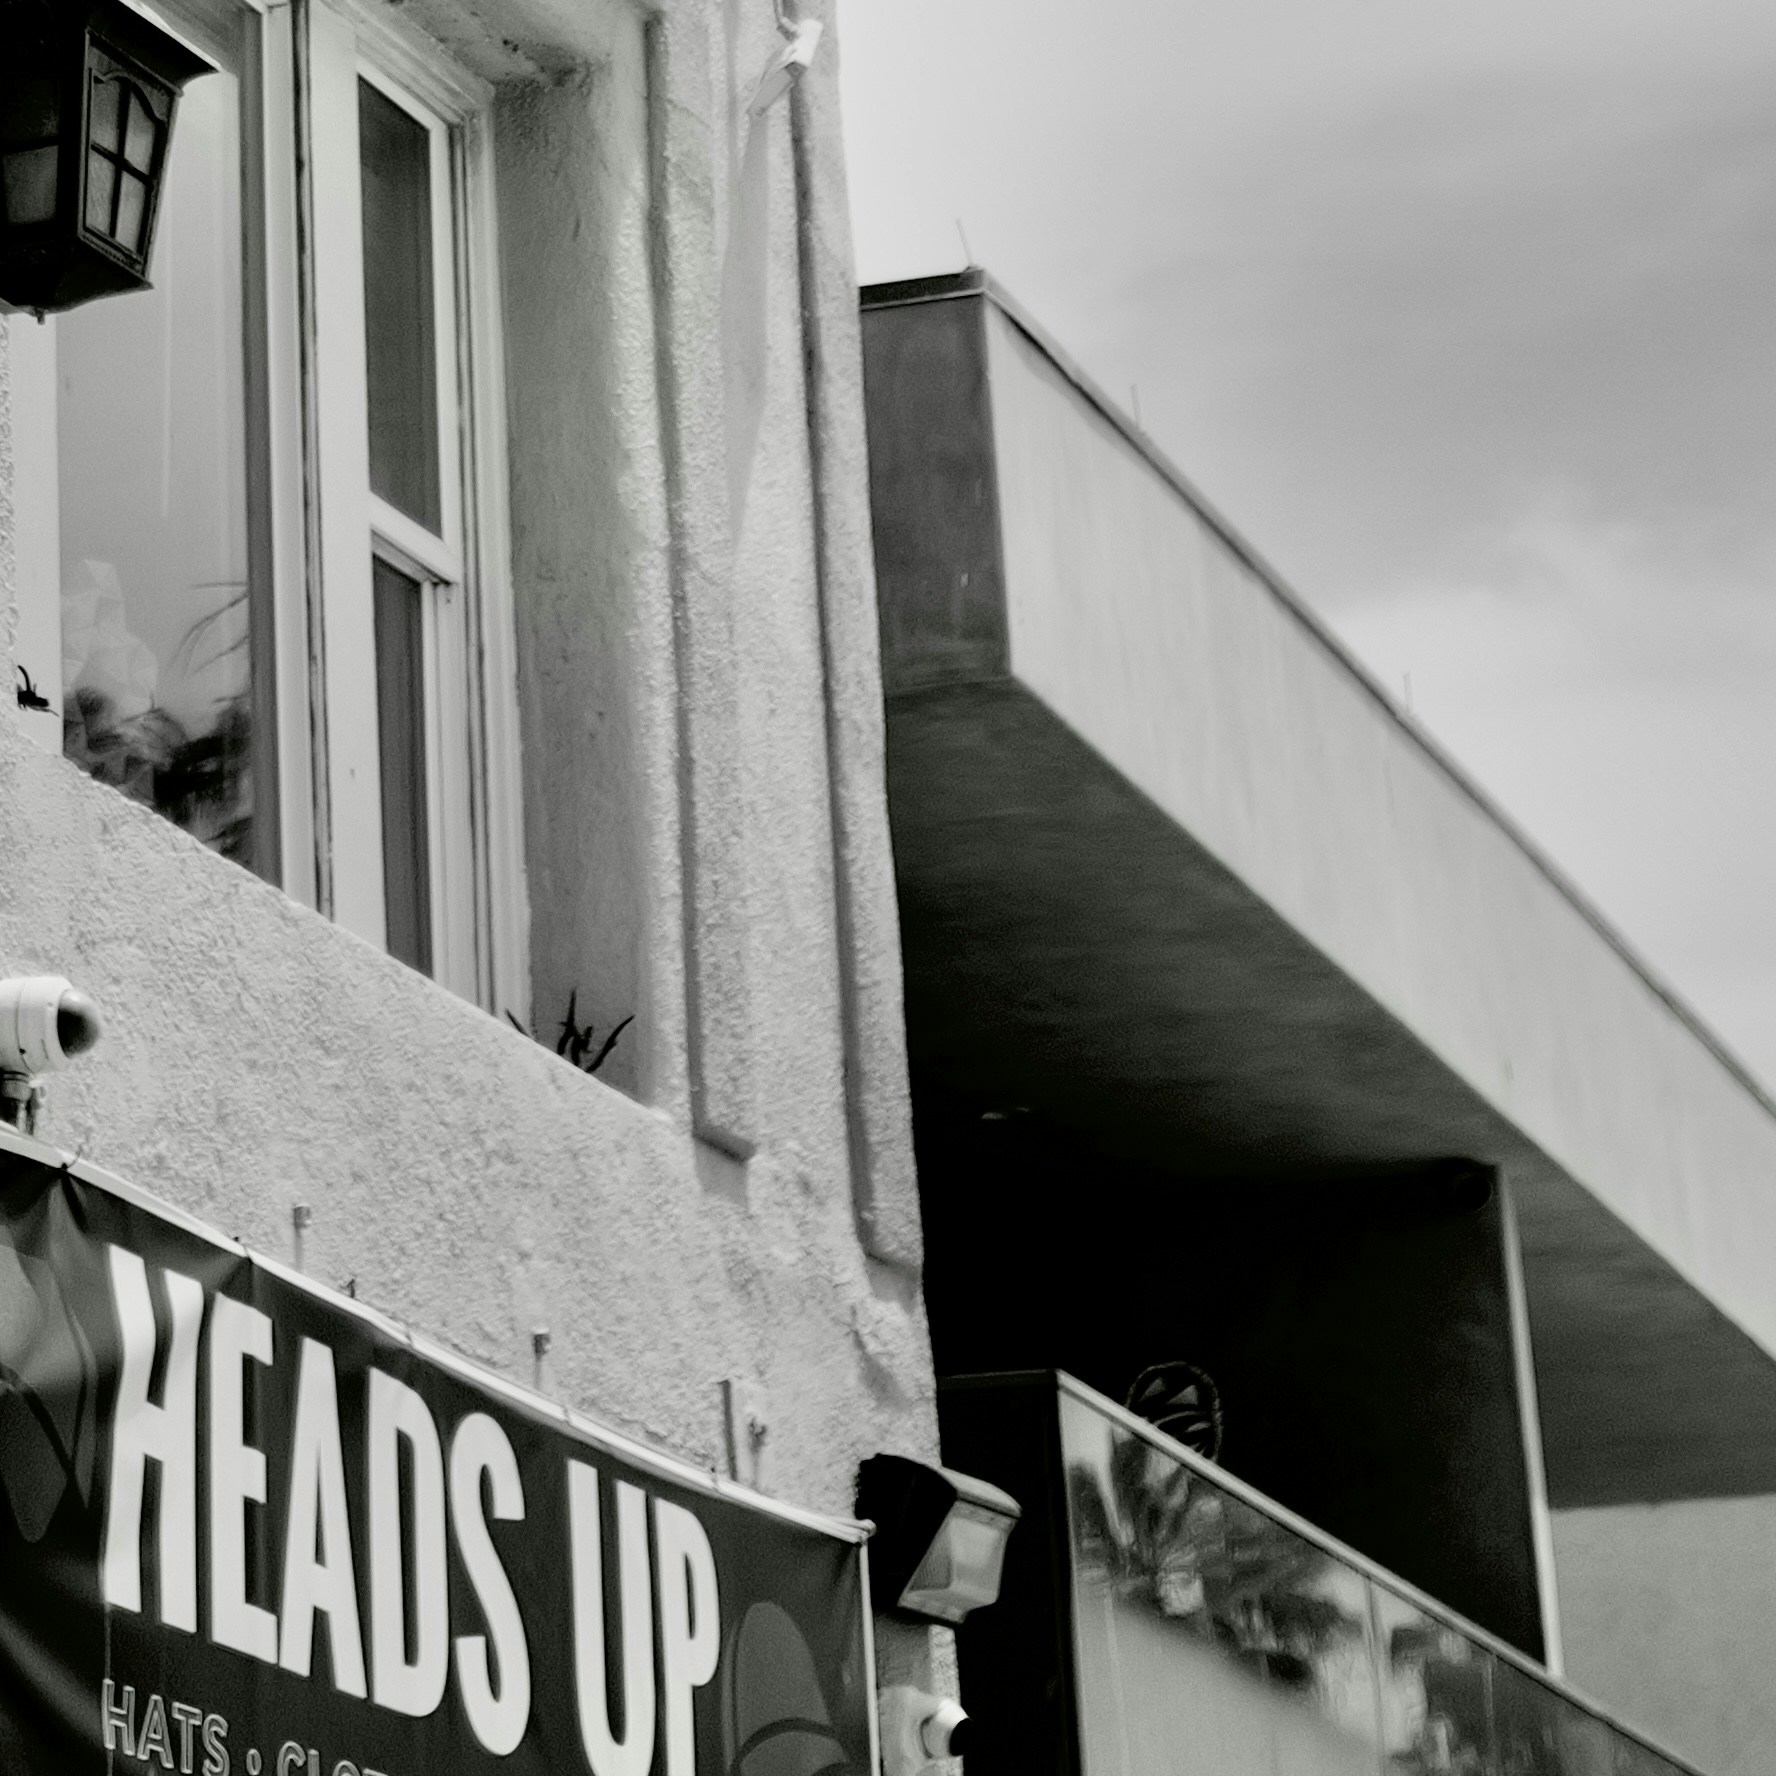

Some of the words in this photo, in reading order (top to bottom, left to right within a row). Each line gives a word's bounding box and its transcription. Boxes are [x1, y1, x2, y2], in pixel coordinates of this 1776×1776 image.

[101, 1244, 531, 1755] HEADS
[568, 1459, 719, 1776] UP
[102, 1678, 229, 1776] HATS
